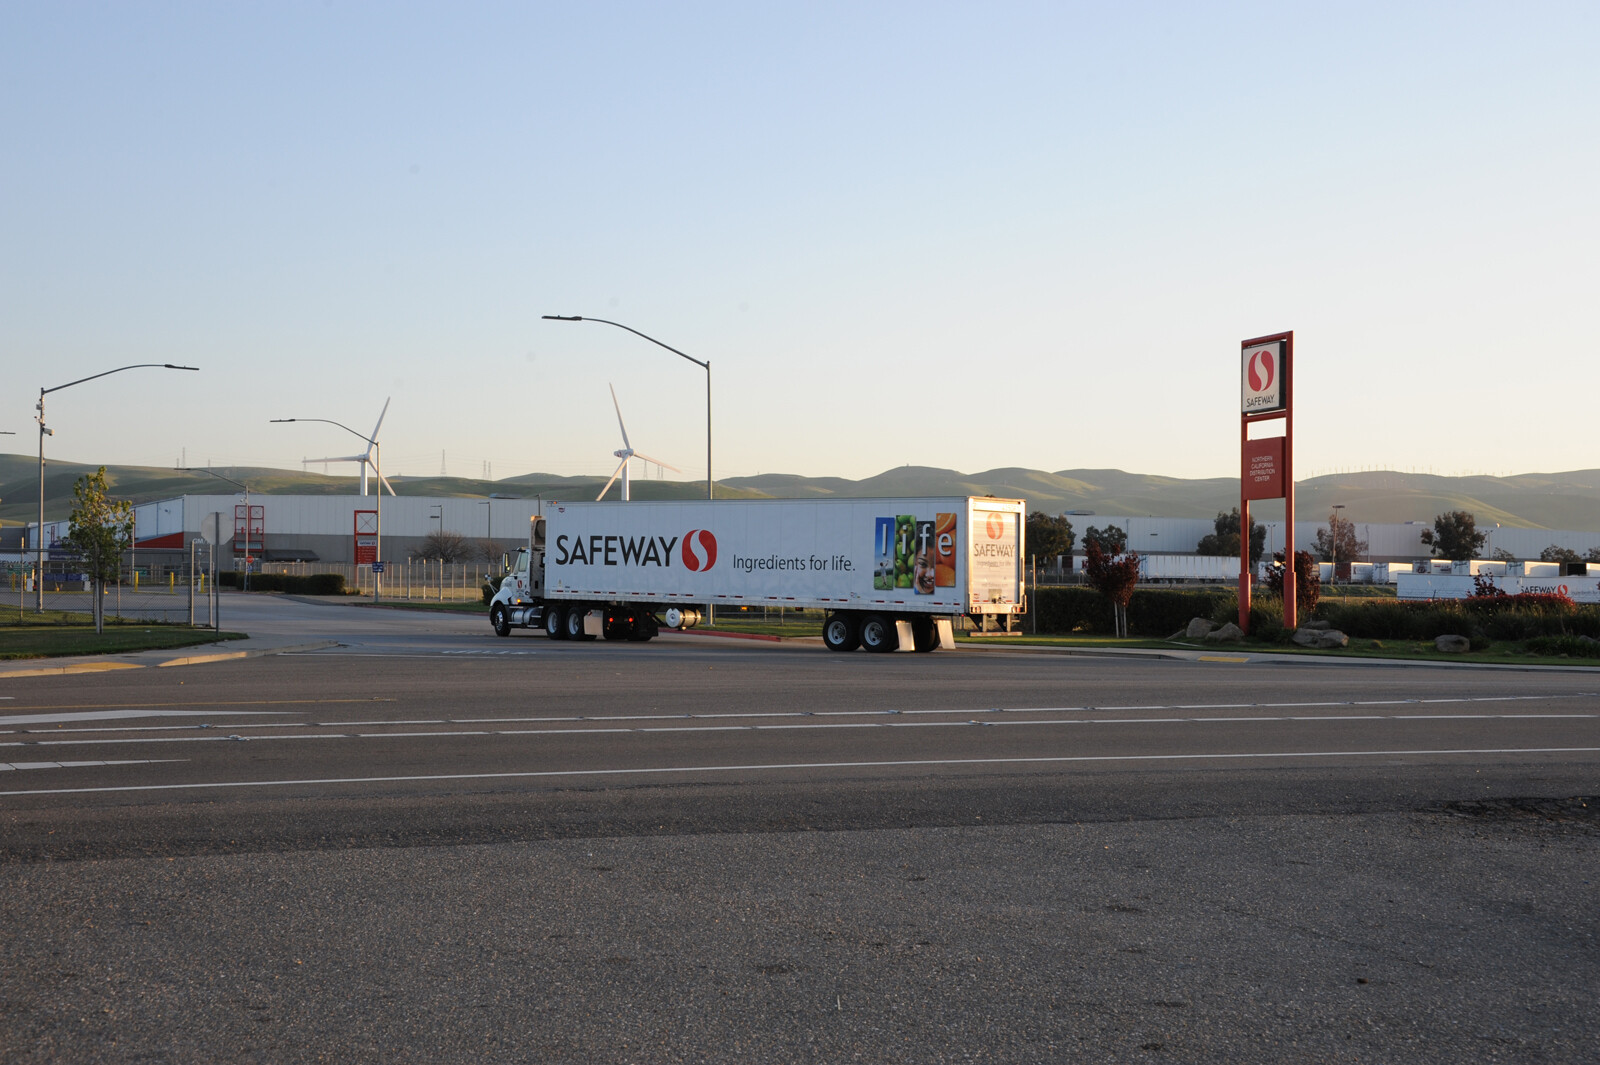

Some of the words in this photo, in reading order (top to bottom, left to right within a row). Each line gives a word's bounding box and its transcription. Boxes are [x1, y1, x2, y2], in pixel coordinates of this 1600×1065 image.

[1246, 395, 1274, 407] SAFEWAY
[881, 523, 953, 557] life
[555, 534, 679, 567] SAFEWAY
[973, 543, 1016, 558] SAFEWAY
[733, 554, 806, 573] Ingredients
[809, 555, 828, 571] for
[831, 555, 856, 571] life.
